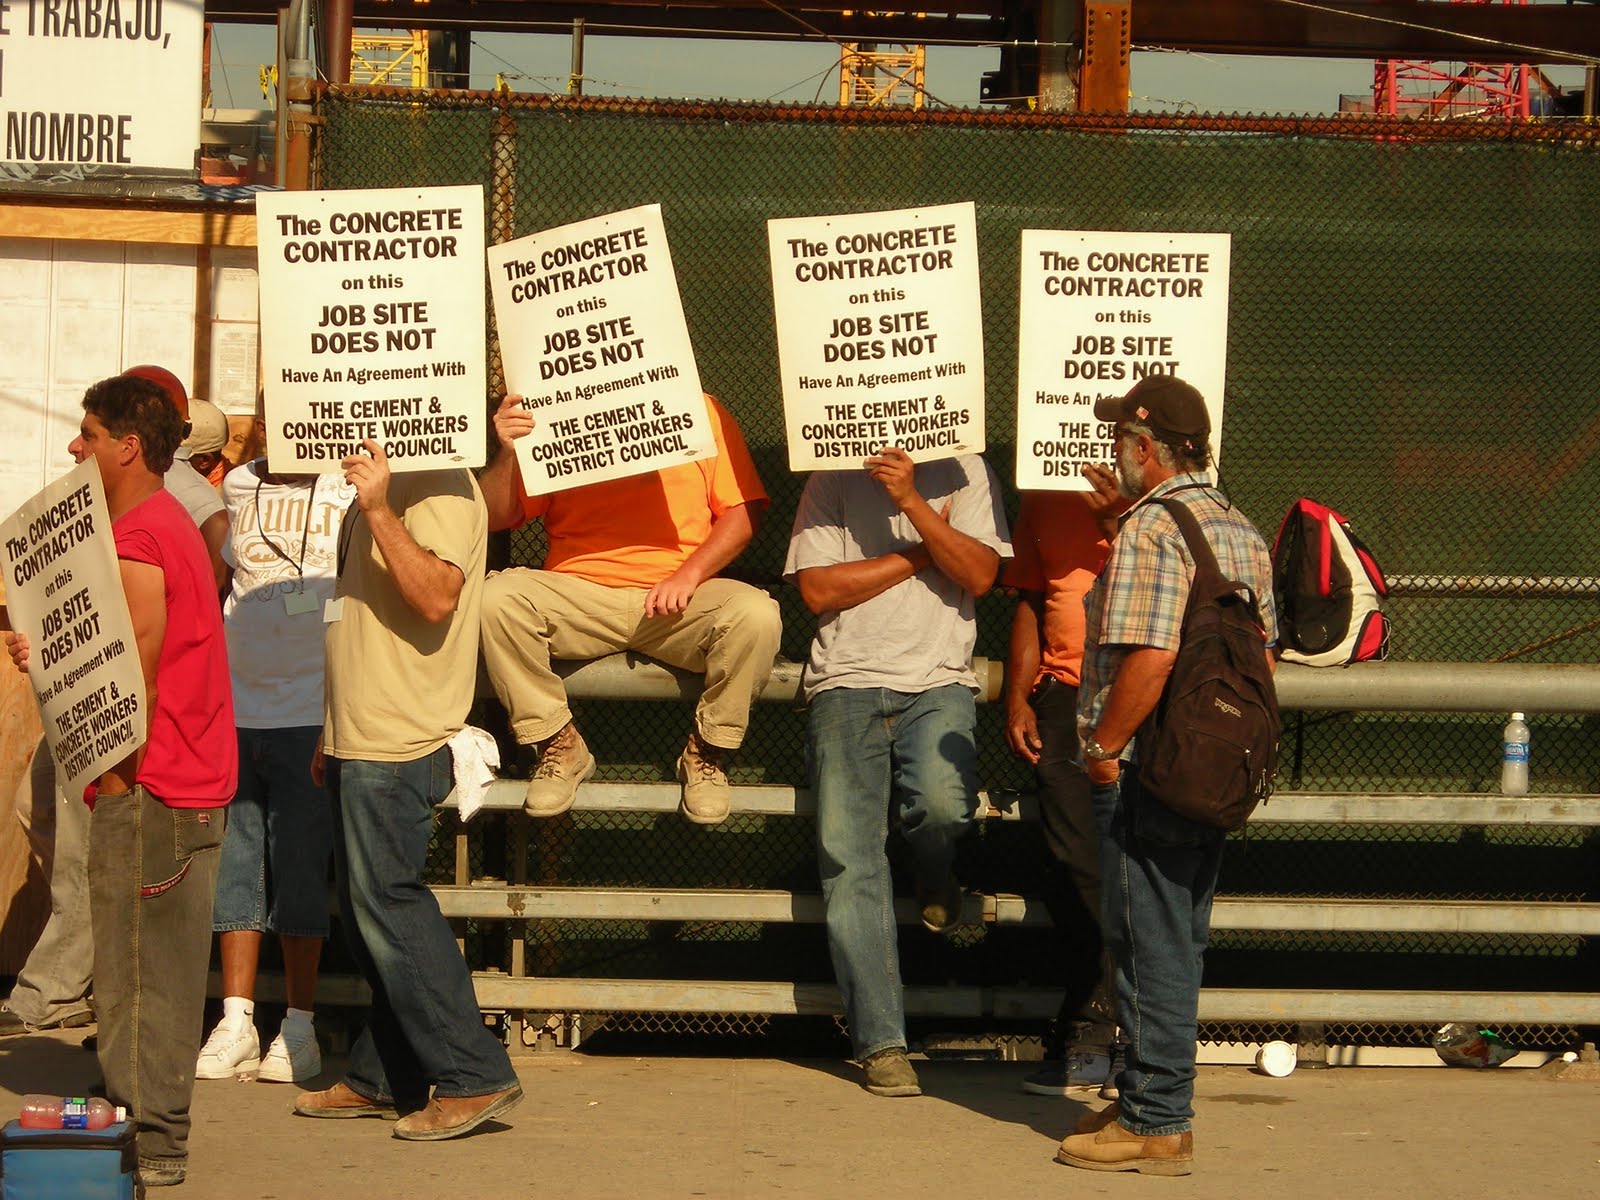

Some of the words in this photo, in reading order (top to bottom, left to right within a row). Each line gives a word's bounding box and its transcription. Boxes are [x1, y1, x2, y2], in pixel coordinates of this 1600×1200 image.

[7, 111, 132, 164] NOMBRE
[277, 214, 321, 236] The
[330, 208, 462, 235] CONCRETE
[284, 236, 457, 263] CONTRACTOR
[503, 260, 536, 281] The
[541, 227, 648, 271] CONCRETE
[787, 239, 828, 258] The
[836, 224, 957, 255] CONCRETE
[795, 250, 953, 282] CONTRACTOR
[1040, 251, 1080, 271] The
[1087, 252, 1209, 273] CONCRETE
[342, 277, 364, 290] on
[368, 274, 404, 288] this
[511, 253, 648, 303] CONTRACTOR
[1044, 276, 1204, 297] CONTRACTOR
[556, 304, 574, 318] on
[577, 296, 607, 314] this
[849, 292, 869, 305] on
[873, 288, 905, 302] this
[318, 305, 365, 327] JOB
[373, 302, 428, 324] SITE
[830, 317, 872, 338] JOB
[879, 311, 929, 334] SITE
[1095, 312, 1115, 323] on
[1120, 310, 1151, 323] this
[311, 331, 379, 354] DOES
[386, 328, 436, 351] NOT
[543, 329, 581, 355] JOB
[587, 316, 635, 344] SITE
[824, 340, 885, 362] DOES
[892, 334, 938, 357] NOT
[1072, 336, 1115, 355] JOB
[1122, 336, 1173, 356] SITE
[282, 369, 318, 383] Have
[323, 368, 342, 382] An
[347, 364, 428, 384] Agreement
[432, 361, 466, 376] With
[539, 350, 597, 380] DOES
[601, 338, 645, 367] NOT
[1064, 361, 1126, 380] DOES
[1133, 361, 1179, 380] NOT
[521, 394, 553, 411] Have
[556, 389, 572, 404] An
[575, 372, 645, 400] Agreement
[647, 365, 679, 383] With
[799, 376, 832, 389] Have
[836, 374, 853, 387] An
[858, 367, 932, 389] Agreement
[935, 362, 966, 378] With
[309, 401, 344, 419] THE
[350, 398, 423, 418] CEMENT
[428, 397, 441, 413] &
[825, 404, 857, 420] THE
[862, 397, 928, 419] CEMENT
[934, 395, 946, 410] &
[1036, 391, 1069, 405] Have
[1073, 392, 1091, 405] An
[283, 422, 377, 439] CONCRETE
[383, 415, 468, 438] WORKERS
[550, 418, 581, 439] THE
[584, 403, 646, 431] CEMENT
[652, 400, 665, 416] &
[802, 421, 888, 440] CONCRETE
[893, 409, 970, 435] WORKERS
[1059, 422, 1090, 439] THE
[296, 442, 371, 459] DISTRIC
[386, 437, 456, 458] COUNCIL
[532, 431, 612, 463] CONCRETE
[614, 412, 694, 444] WORKERS
[895, 429, 960, 453] COUNCIL
[545, 449, 615, 478] DISTRICT
[620, 434, 688, 462] COUNCIL
[6, 536, 28, 562] The
[29, 483, 93, 546] CONCRETE
[14, 513, 95, 587] CONTRACTOR
[46, 584, 55, 598] on
[55, 569, 72, 590] this
[42, 608, 63, 641] JOB
[63, 587, 92, 623] SITE
[41, 631, 73, 670] DOES
[74, 612, 101, 648] NOT
[53, 680, 63, 694] An
[63, 651, 104, 688] Agreement
[103, 639, 125, 662] With
[56, 710, 73, 736] THE
[72, 686, 108, 724] CEMENT
[110, 681, 119, 700] &
[55, 723, 91, 763] CONCRETE
[90, 693, 138, 736] WORKERS
[64, 743, 95, 781] DISTRICT
[96, 719, 134, 757] COUNCIL
